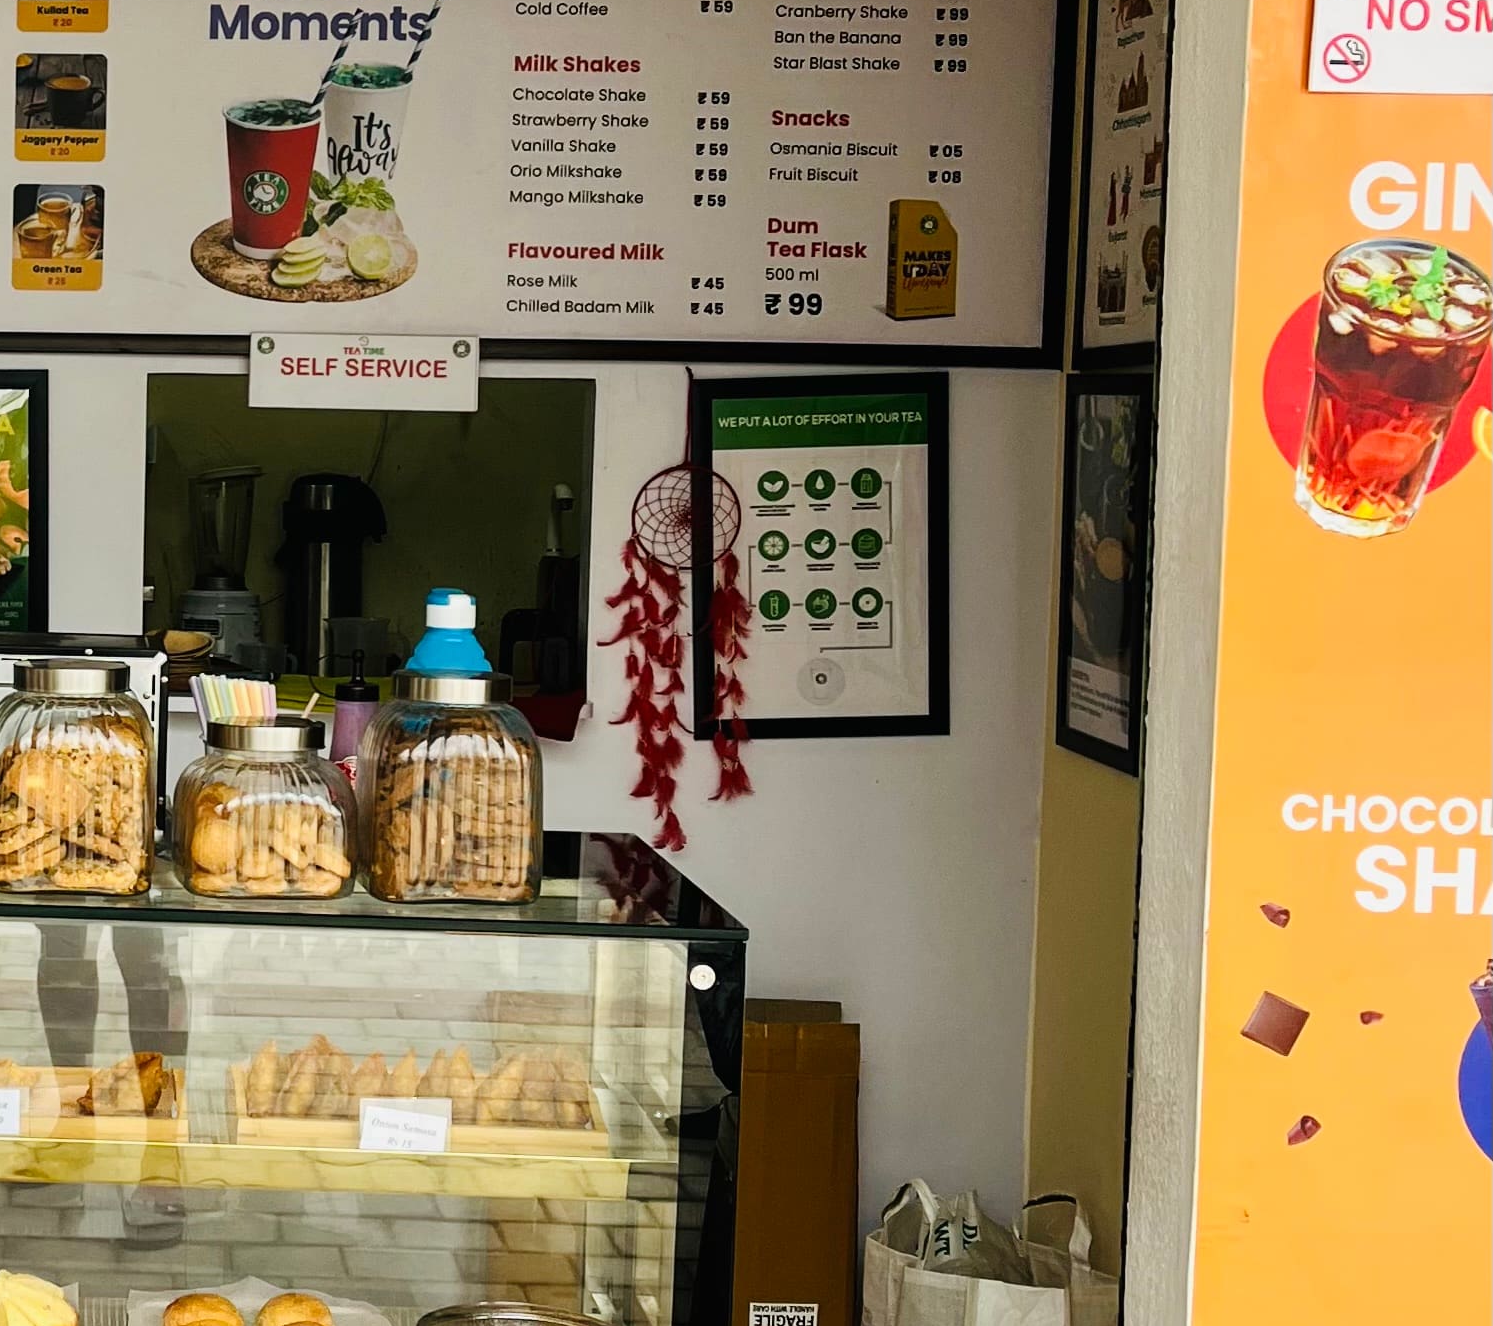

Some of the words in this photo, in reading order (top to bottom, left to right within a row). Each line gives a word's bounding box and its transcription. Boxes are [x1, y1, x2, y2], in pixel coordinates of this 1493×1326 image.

[516, 2, 552, 15] Cold
[557, 2, 608, 16] Coffee
[209, 4, 431, 41] Moments
[514, 55, 558, 72] Milk
[563, 57, 640, 72] Shakes
[773, 57, 805, 69] Star
[810, 57, 847, 70] Blast
[852, 57, 900, 70] Shake
[513, 88, 594, 101] Chocolate
[599, 88, 646, 102] Shake
[512, 114, 596, 129] Strawberry
[602, 114, 648, 128] Shake
[772, 110, 850, 126] Snacks
[21, 135, 60, 146] Jaggery
[64, 135, 99, 145] Pepper
[352, 112, 392, 154] It's
[770, 143, 842, 156] Osmania
[847, 143, 898, 156] Biscuit
[510, 190, 563, 206] Mango
[568, 190, 643, 204] Milkshake
[768, 218, 818, 234] Dum
[508, 243, 614, 259] Flavoured
[620, 244, 664, 260] Milk
[767, 242, 805, 257] Tea
[811, 242, 867, 258] Flask
[33, 265, 62, 274] Green
[66, 265, 82, 274] Tea
[766, 268, 794, 281] 500
[799, 268, 819, 281] ml
[507, 275, 544, 287] Rose
[549, 275, 577, 288] Milk
[788, 293, 822, 315] 99
[281, 357, 337, 376] SELF
[346, 359, 447, 378] SERVICE
[719, 417, 737, 427] WE
[739, 417, 760, 427] PUT
[762, 417, 771, 426] A
[773, 415, 792, 426] LOT
[795, 415, 809, 426] OF
[812, 414, 853, 424] EFFORT
[856, 414, 865, 423] IN
[868, 412, 899, 423] YOUR
[901, 412, 922, 421] TEA
[754, 1315, 814, 1326] FRAGILE
